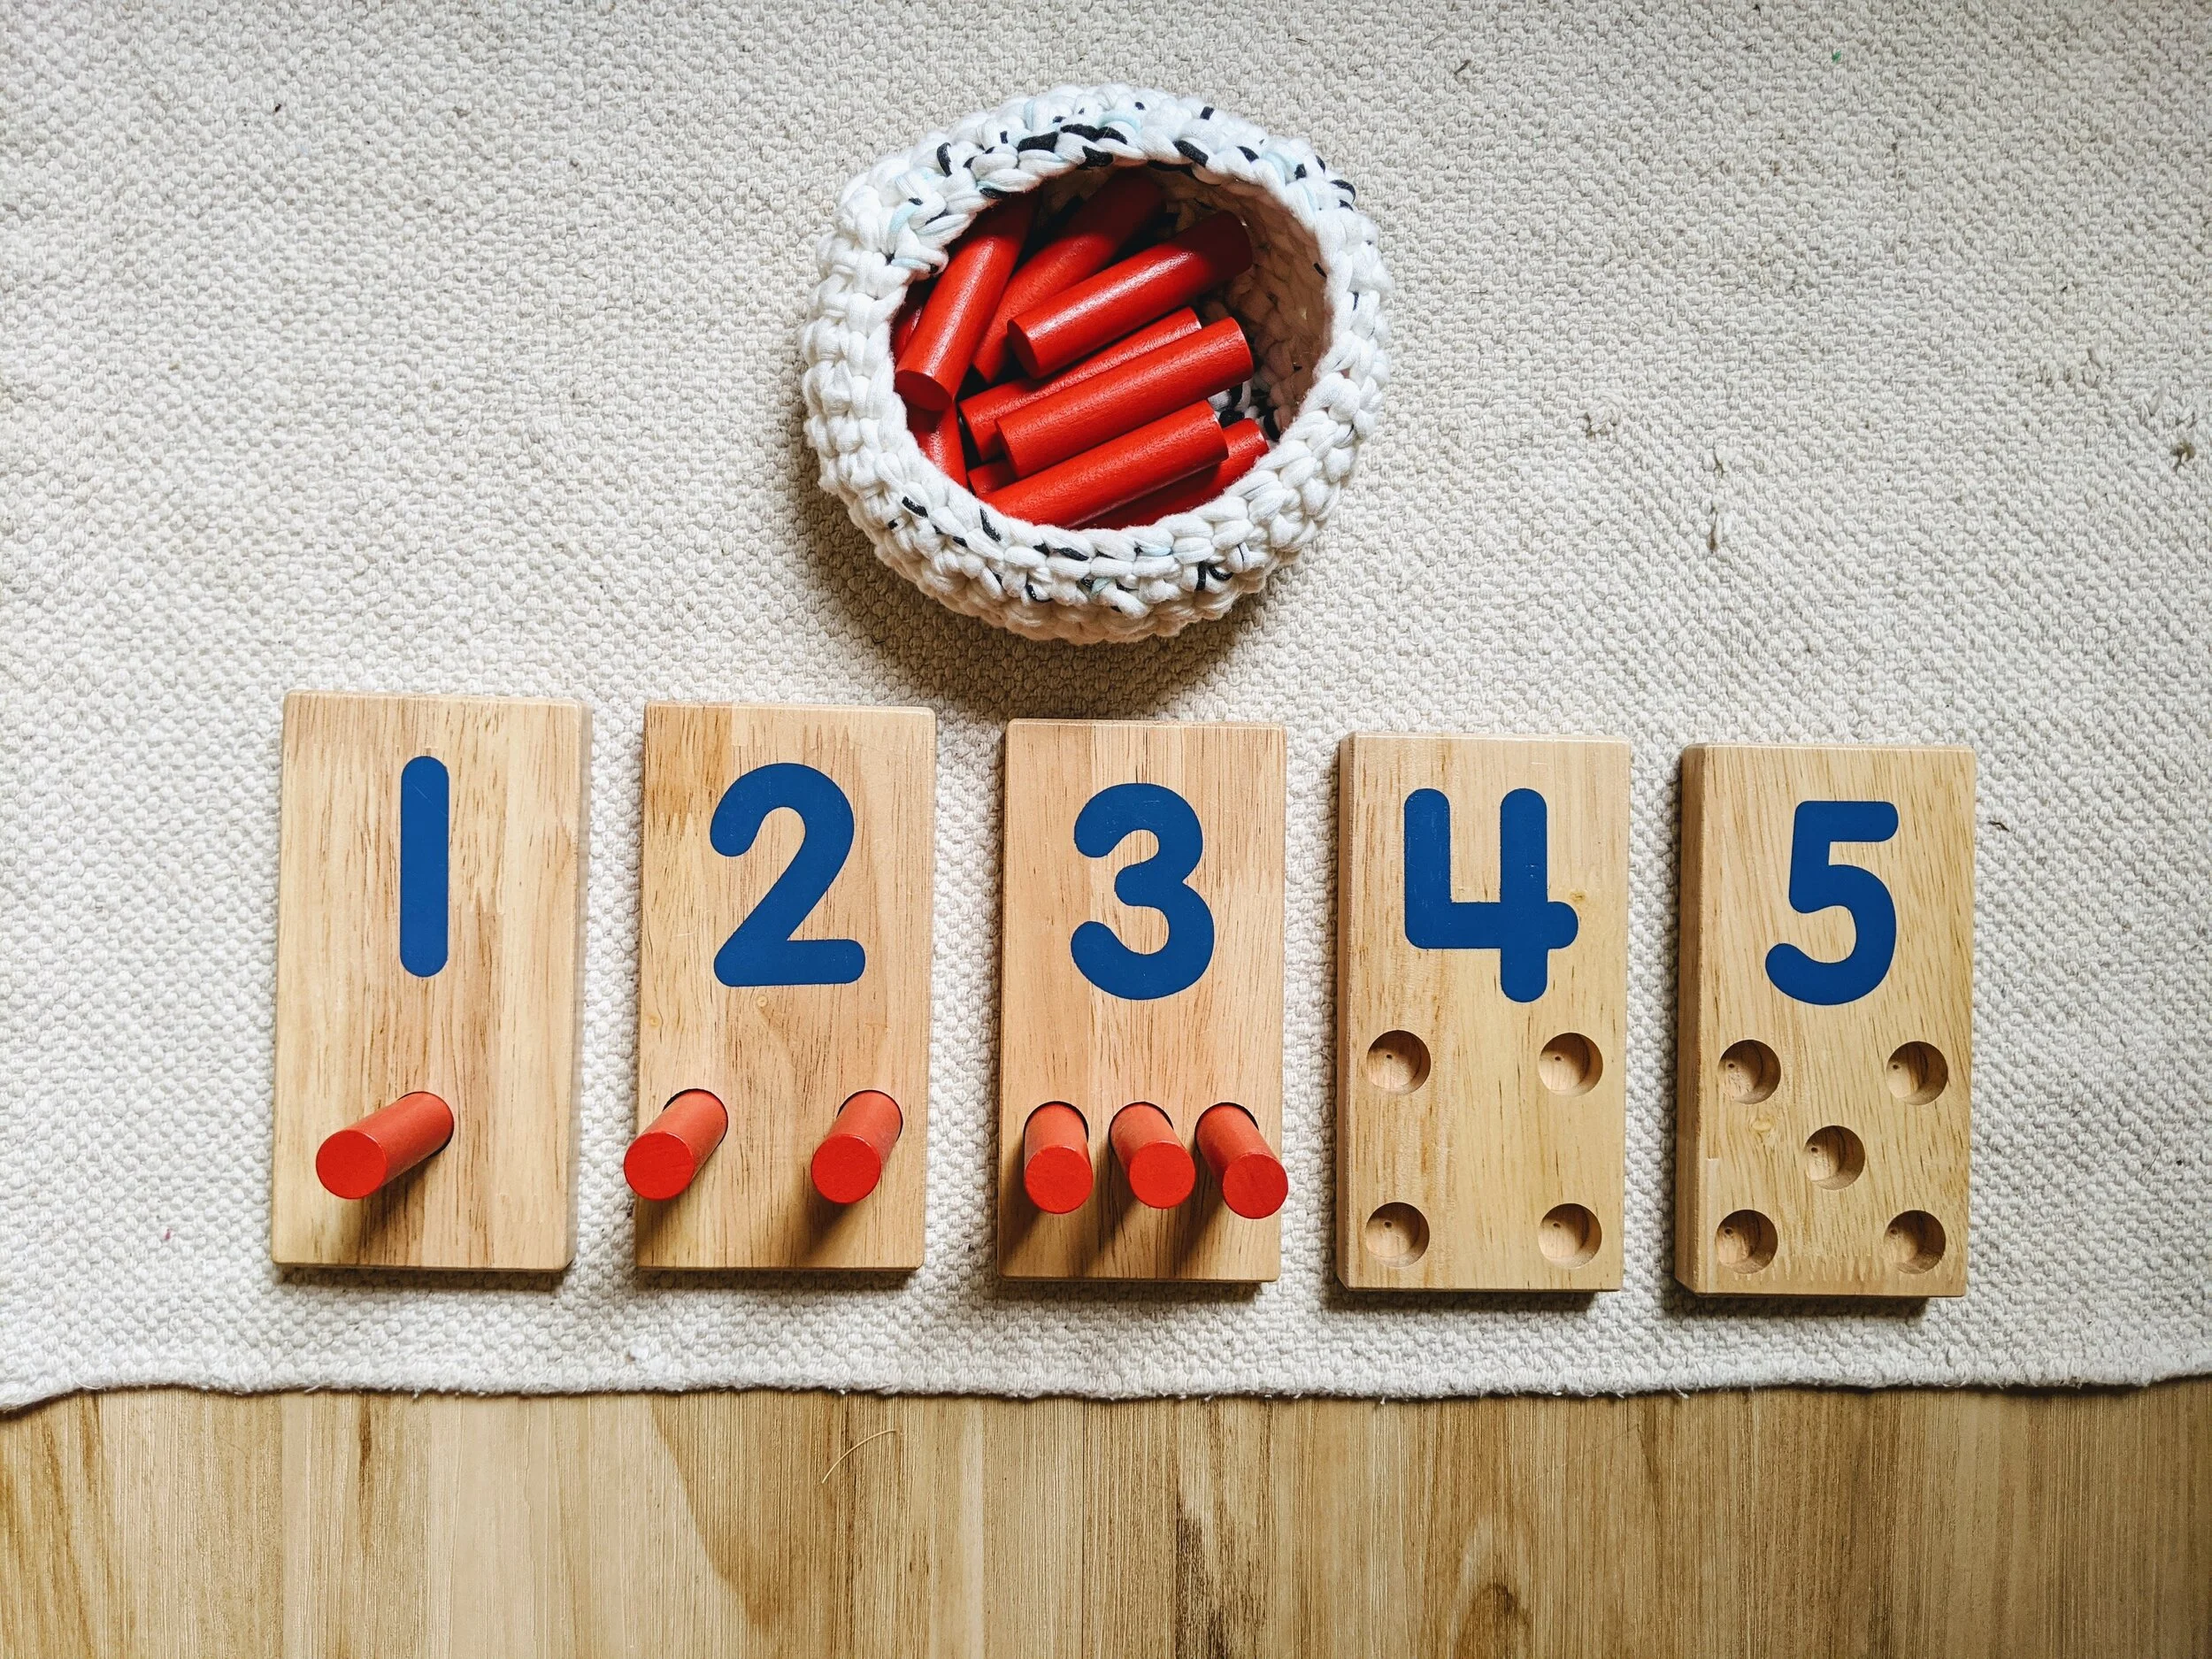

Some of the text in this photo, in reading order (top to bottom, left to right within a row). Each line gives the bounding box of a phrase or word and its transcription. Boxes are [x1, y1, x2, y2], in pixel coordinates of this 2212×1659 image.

[401, 757, 449, 977] 1
[711, 764, 864, 987] 2
[1071, 784, 1214, 1000] 3
[1405, 789, 1578, 1002] 4
[1767, 802, 1898, 1005] 5
